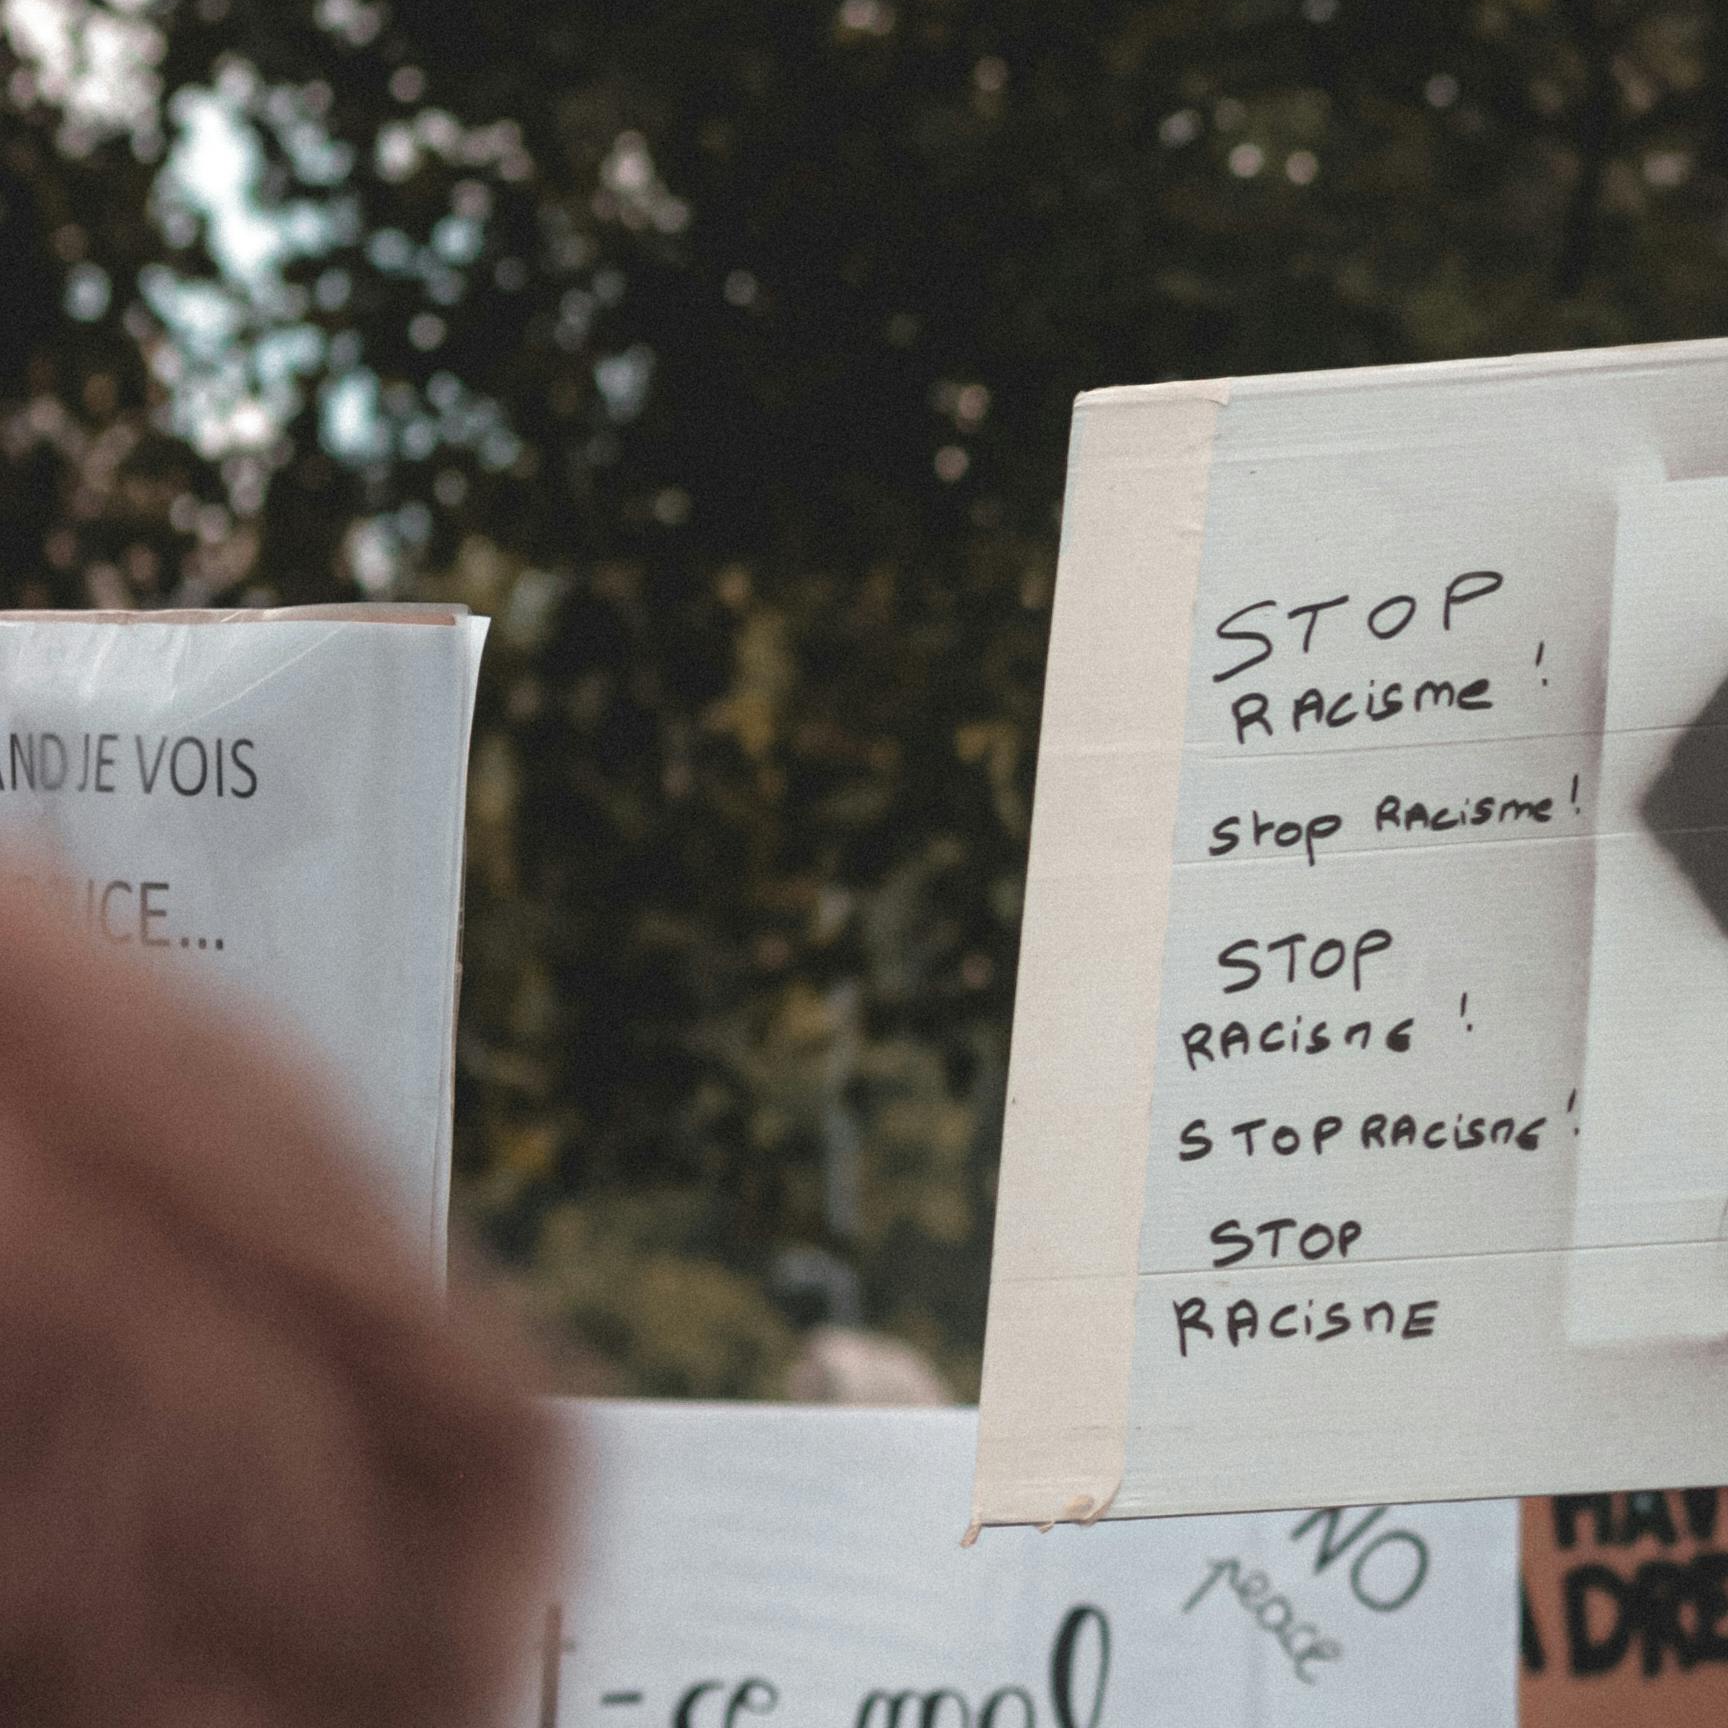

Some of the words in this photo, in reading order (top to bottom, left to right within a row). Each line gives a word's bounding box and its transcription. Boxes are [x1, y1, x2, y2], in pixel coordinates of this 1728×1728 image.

[1213, 571, 1503, 683] STOP
[0, 733, 68, 791] ND
[75, 733, 119, 793] JE
[135, 734, 258, 798] VOIS
[1209, 810, 1342, 867] stop
[1217, 929, 1393, 994] STOP
[1179, 1118, 1343, 1162] STOP
[1210, 1218, 1363, 1268] STOP
[1289, 1506, 1431, 1613] NO
[1182, 1556, 1344, 1685] peace
